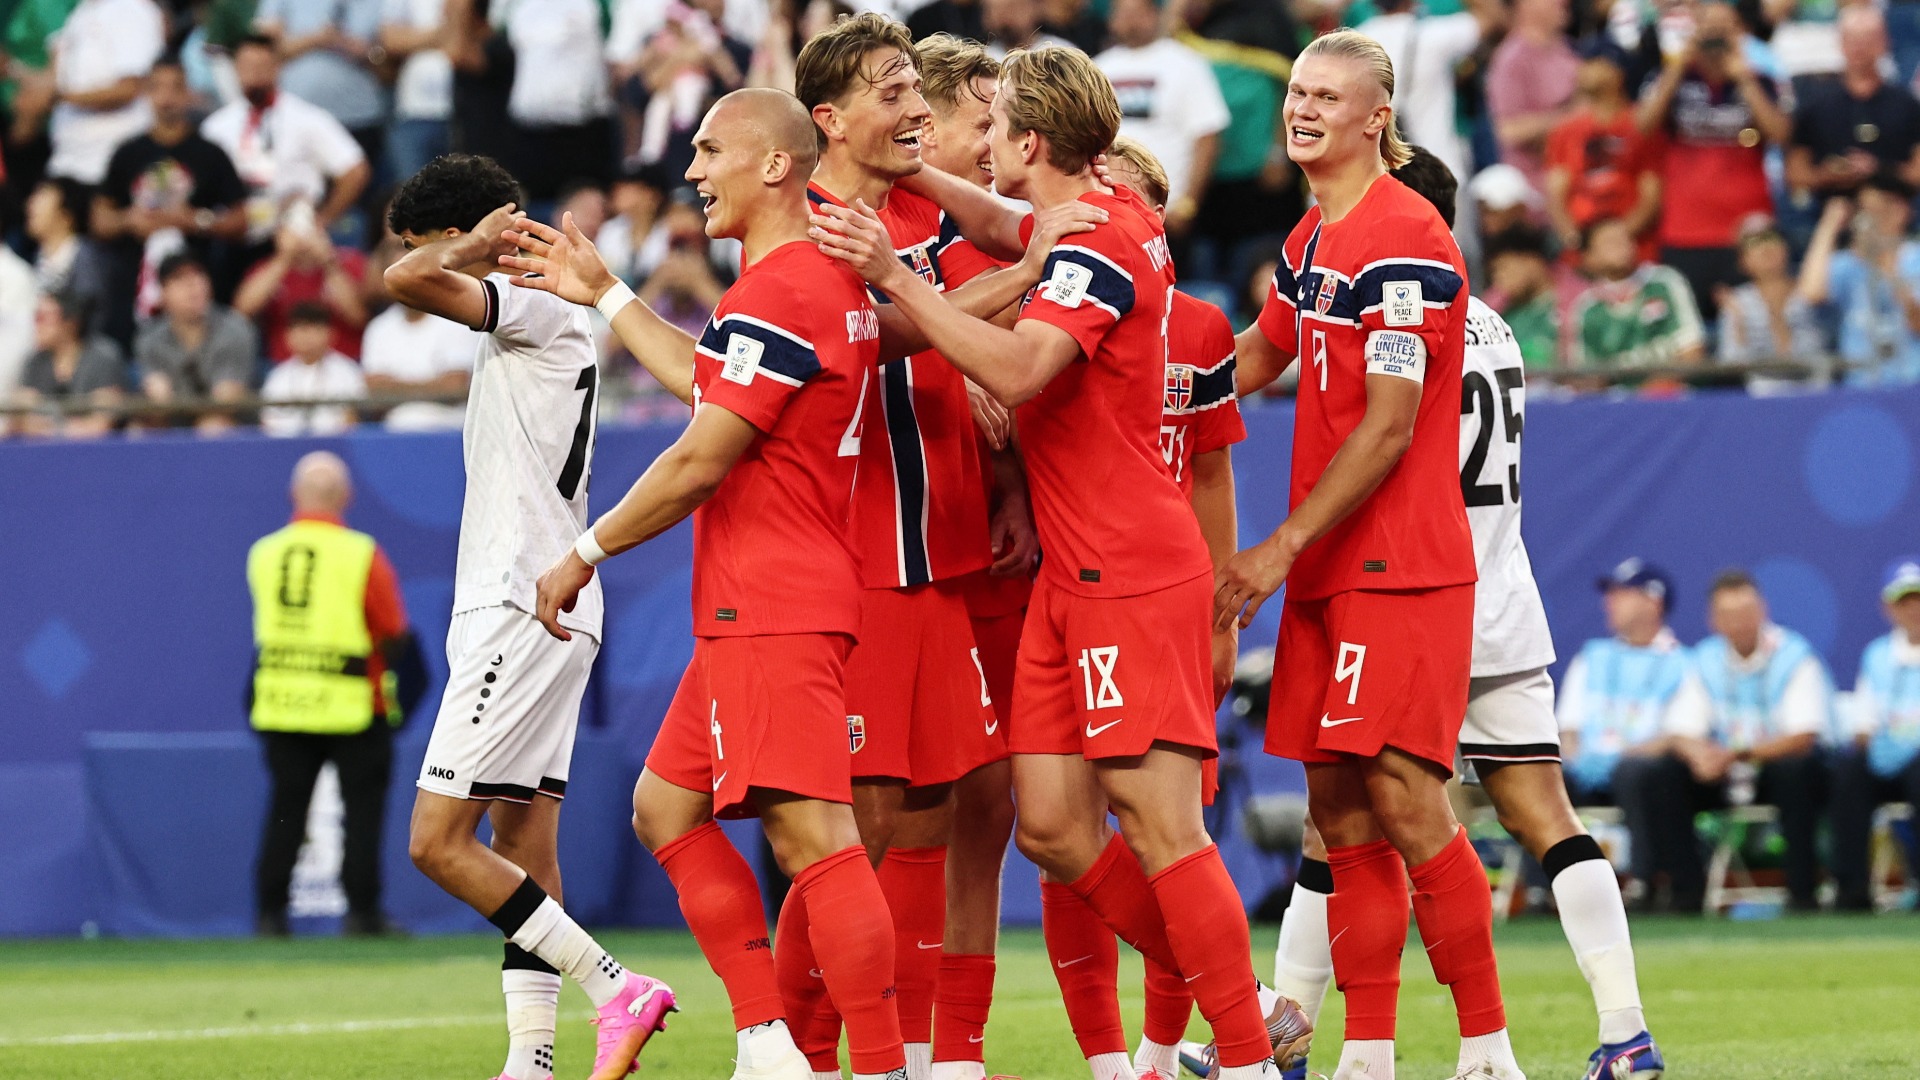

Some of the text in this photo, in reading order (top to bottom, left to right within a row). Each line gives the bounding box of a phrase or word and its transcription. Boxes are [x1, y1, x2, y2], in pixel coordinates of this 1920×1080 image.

[1394, 307, 1412, 316] PEACE
[1375, 341, 1416, 357] UNITES
[1379, 333, 1417, 347] FOOTBALL
[1312, 329, 1328, 392] 9
[1373, 353, 1416, 368] the World
[1385, 365, 1402, 373] FIFA
[557, 364, 598, 500] 1
[1460, 367, 1523, 508] 25
[1078, 645, 1124, 711] 18
[1334, 641, 1367, 705] 9
[711, 698, 724, 760] 4
[427, 765, 455, 780] JAKO
